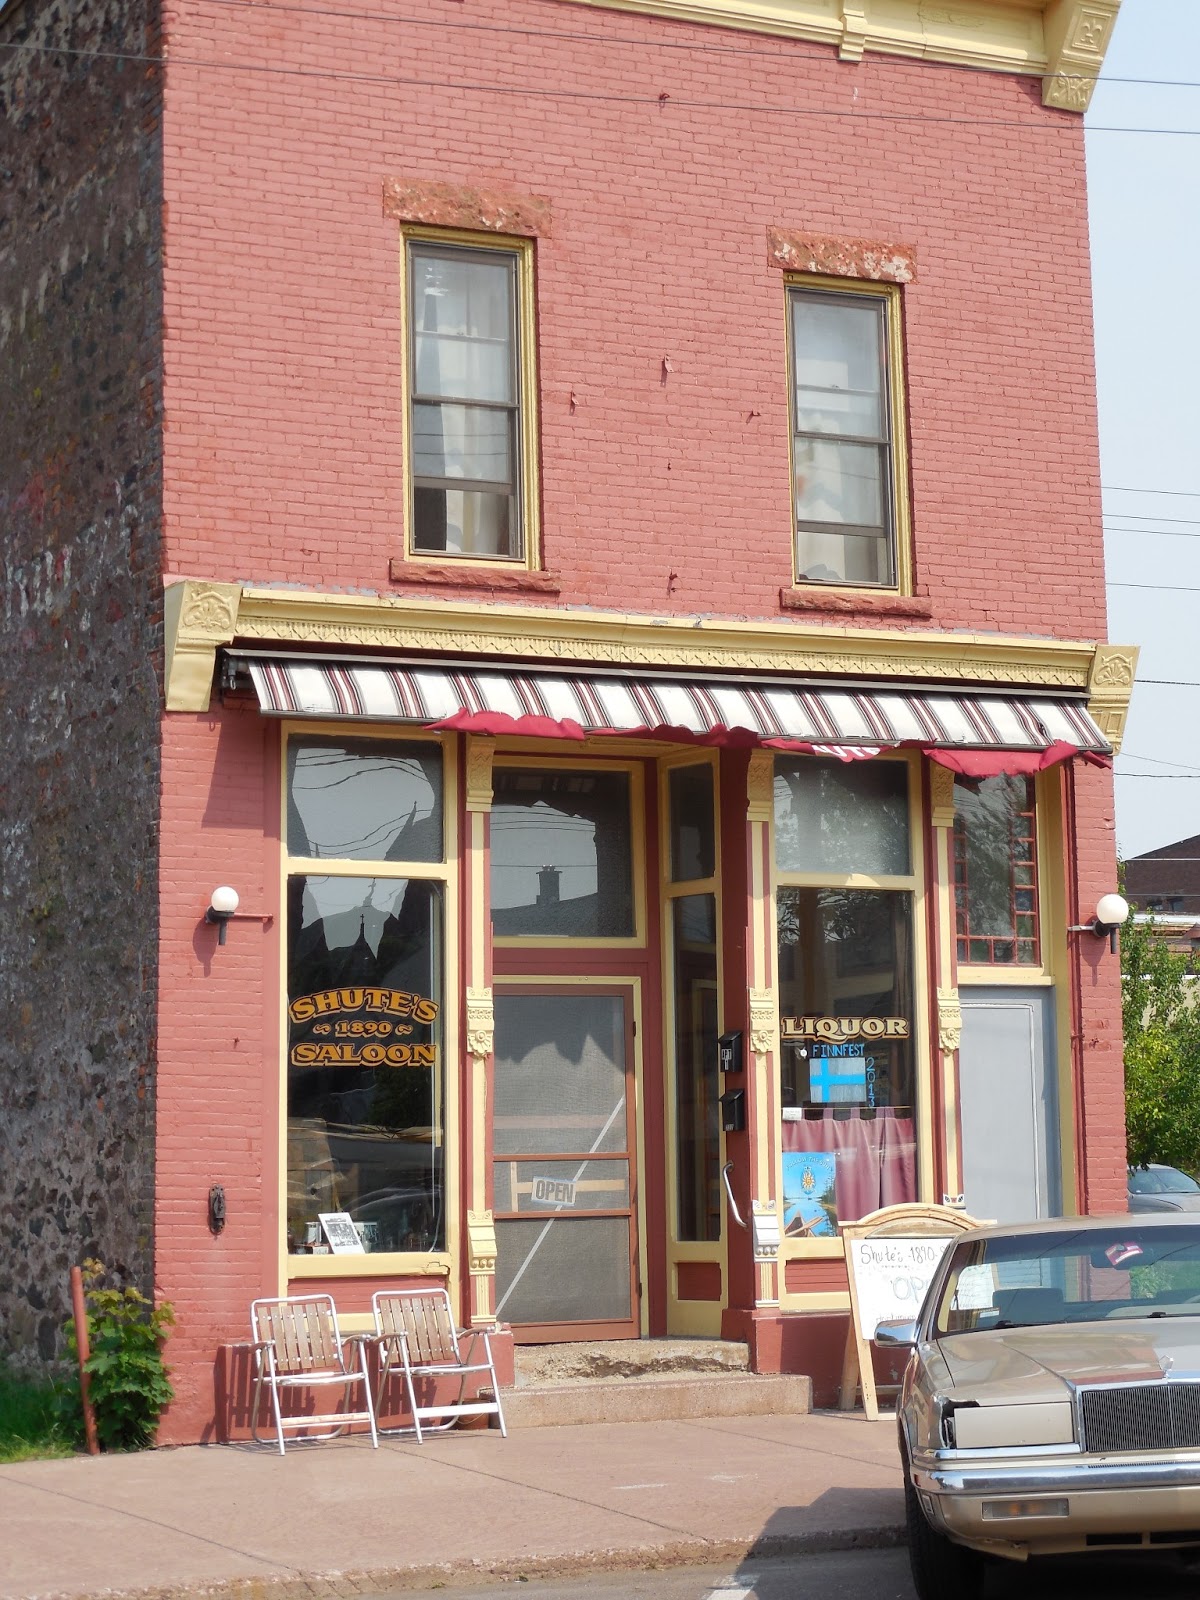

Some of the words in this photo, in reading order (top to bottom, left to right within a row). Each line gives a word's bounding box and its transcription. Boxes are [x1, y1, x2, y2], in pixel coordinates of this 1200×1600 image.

[289, 986, 439, 1024] SHUTE'S
[335, 1021, 393, 1038] 1890
[781, 1017, 909, 1044] LIQUOR
[291, 1043, 437, 1067] SALOON
[812, 1044, 865, 1057] FINNFEST
[535, 1180, 574, 1203] OPEN
